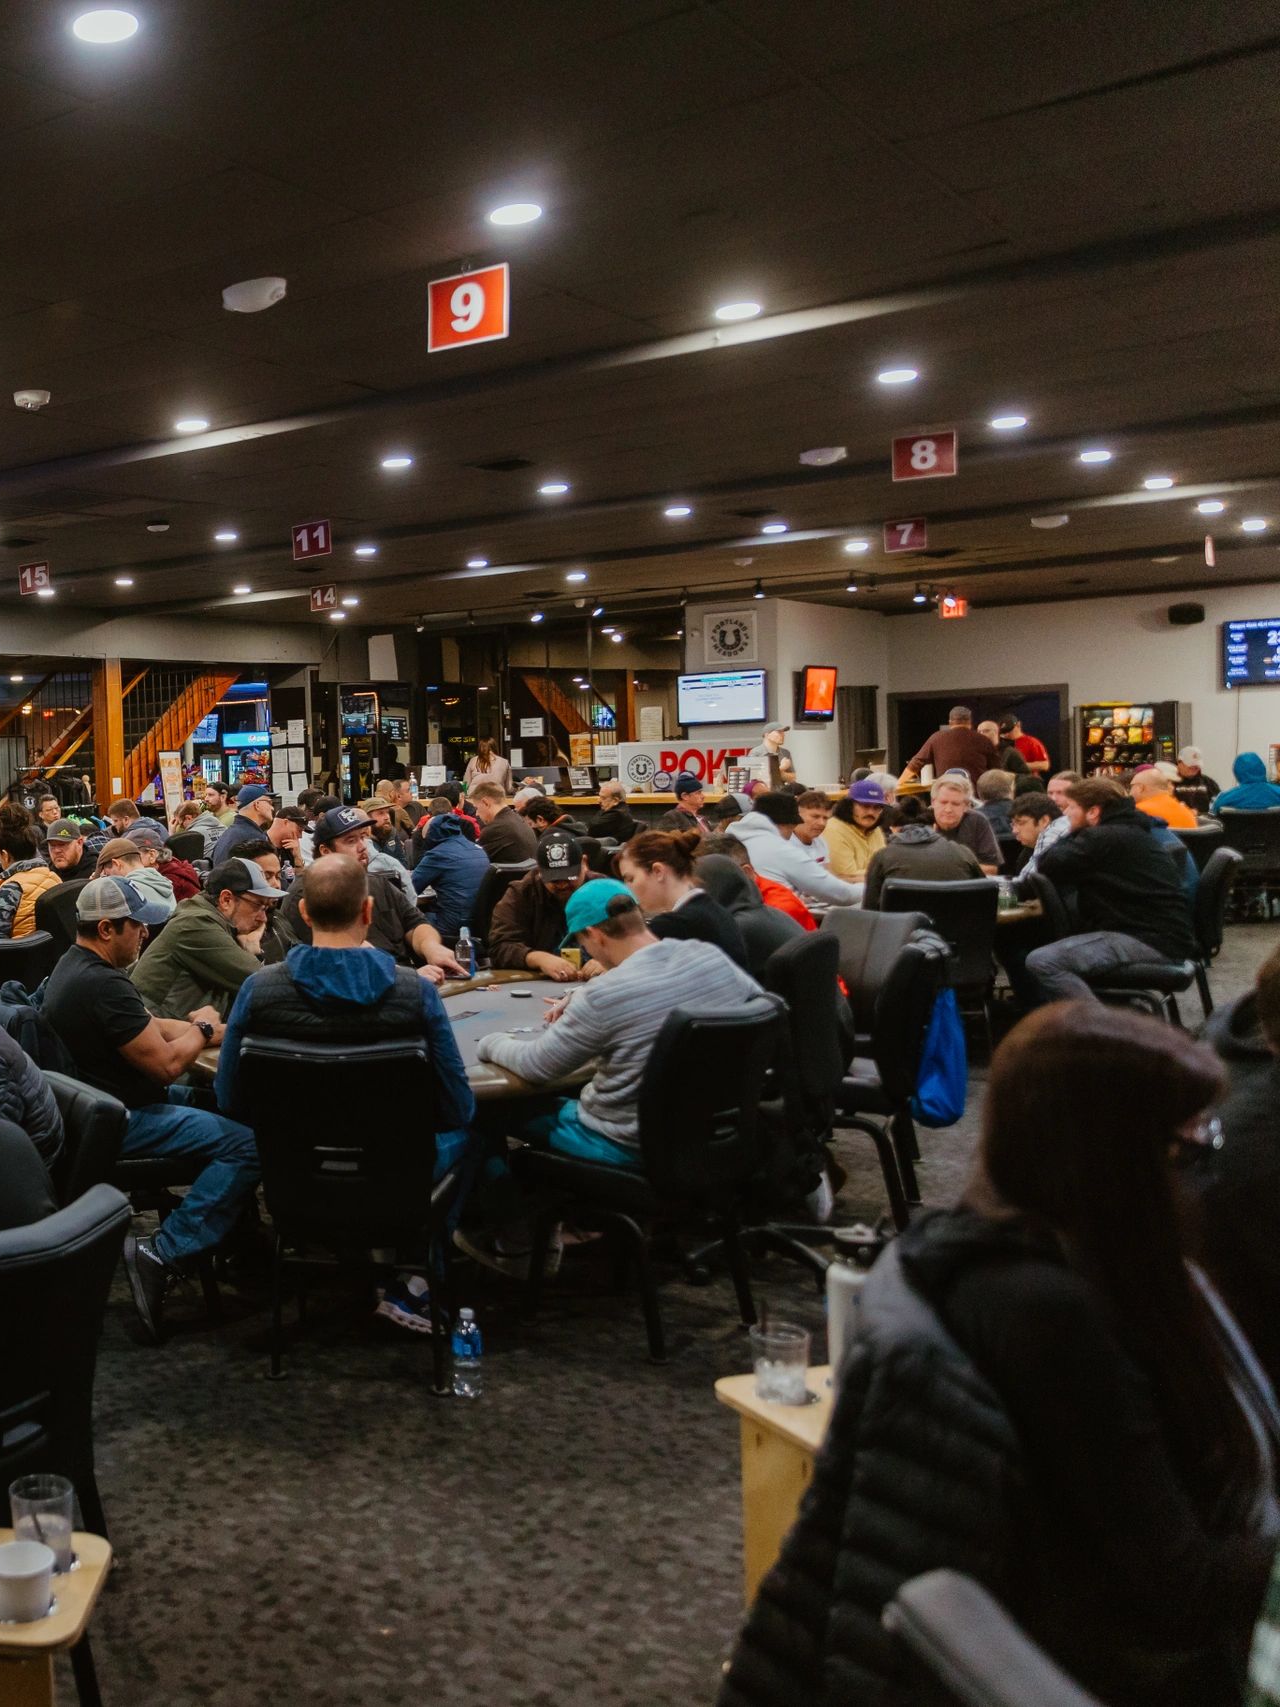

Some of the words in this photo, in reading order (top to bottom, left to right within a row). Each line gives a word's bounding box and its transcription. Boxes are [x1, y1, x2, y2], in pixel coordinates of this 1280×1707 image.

[451, 282, 485, 333] 9
[910, 440, 937, 470] 8
[296, 525, 325, 552] 11
[895, 523, 914, 545] 7
[22, 565, 47, 588] 15
[313, 587, 335, 606] 14
